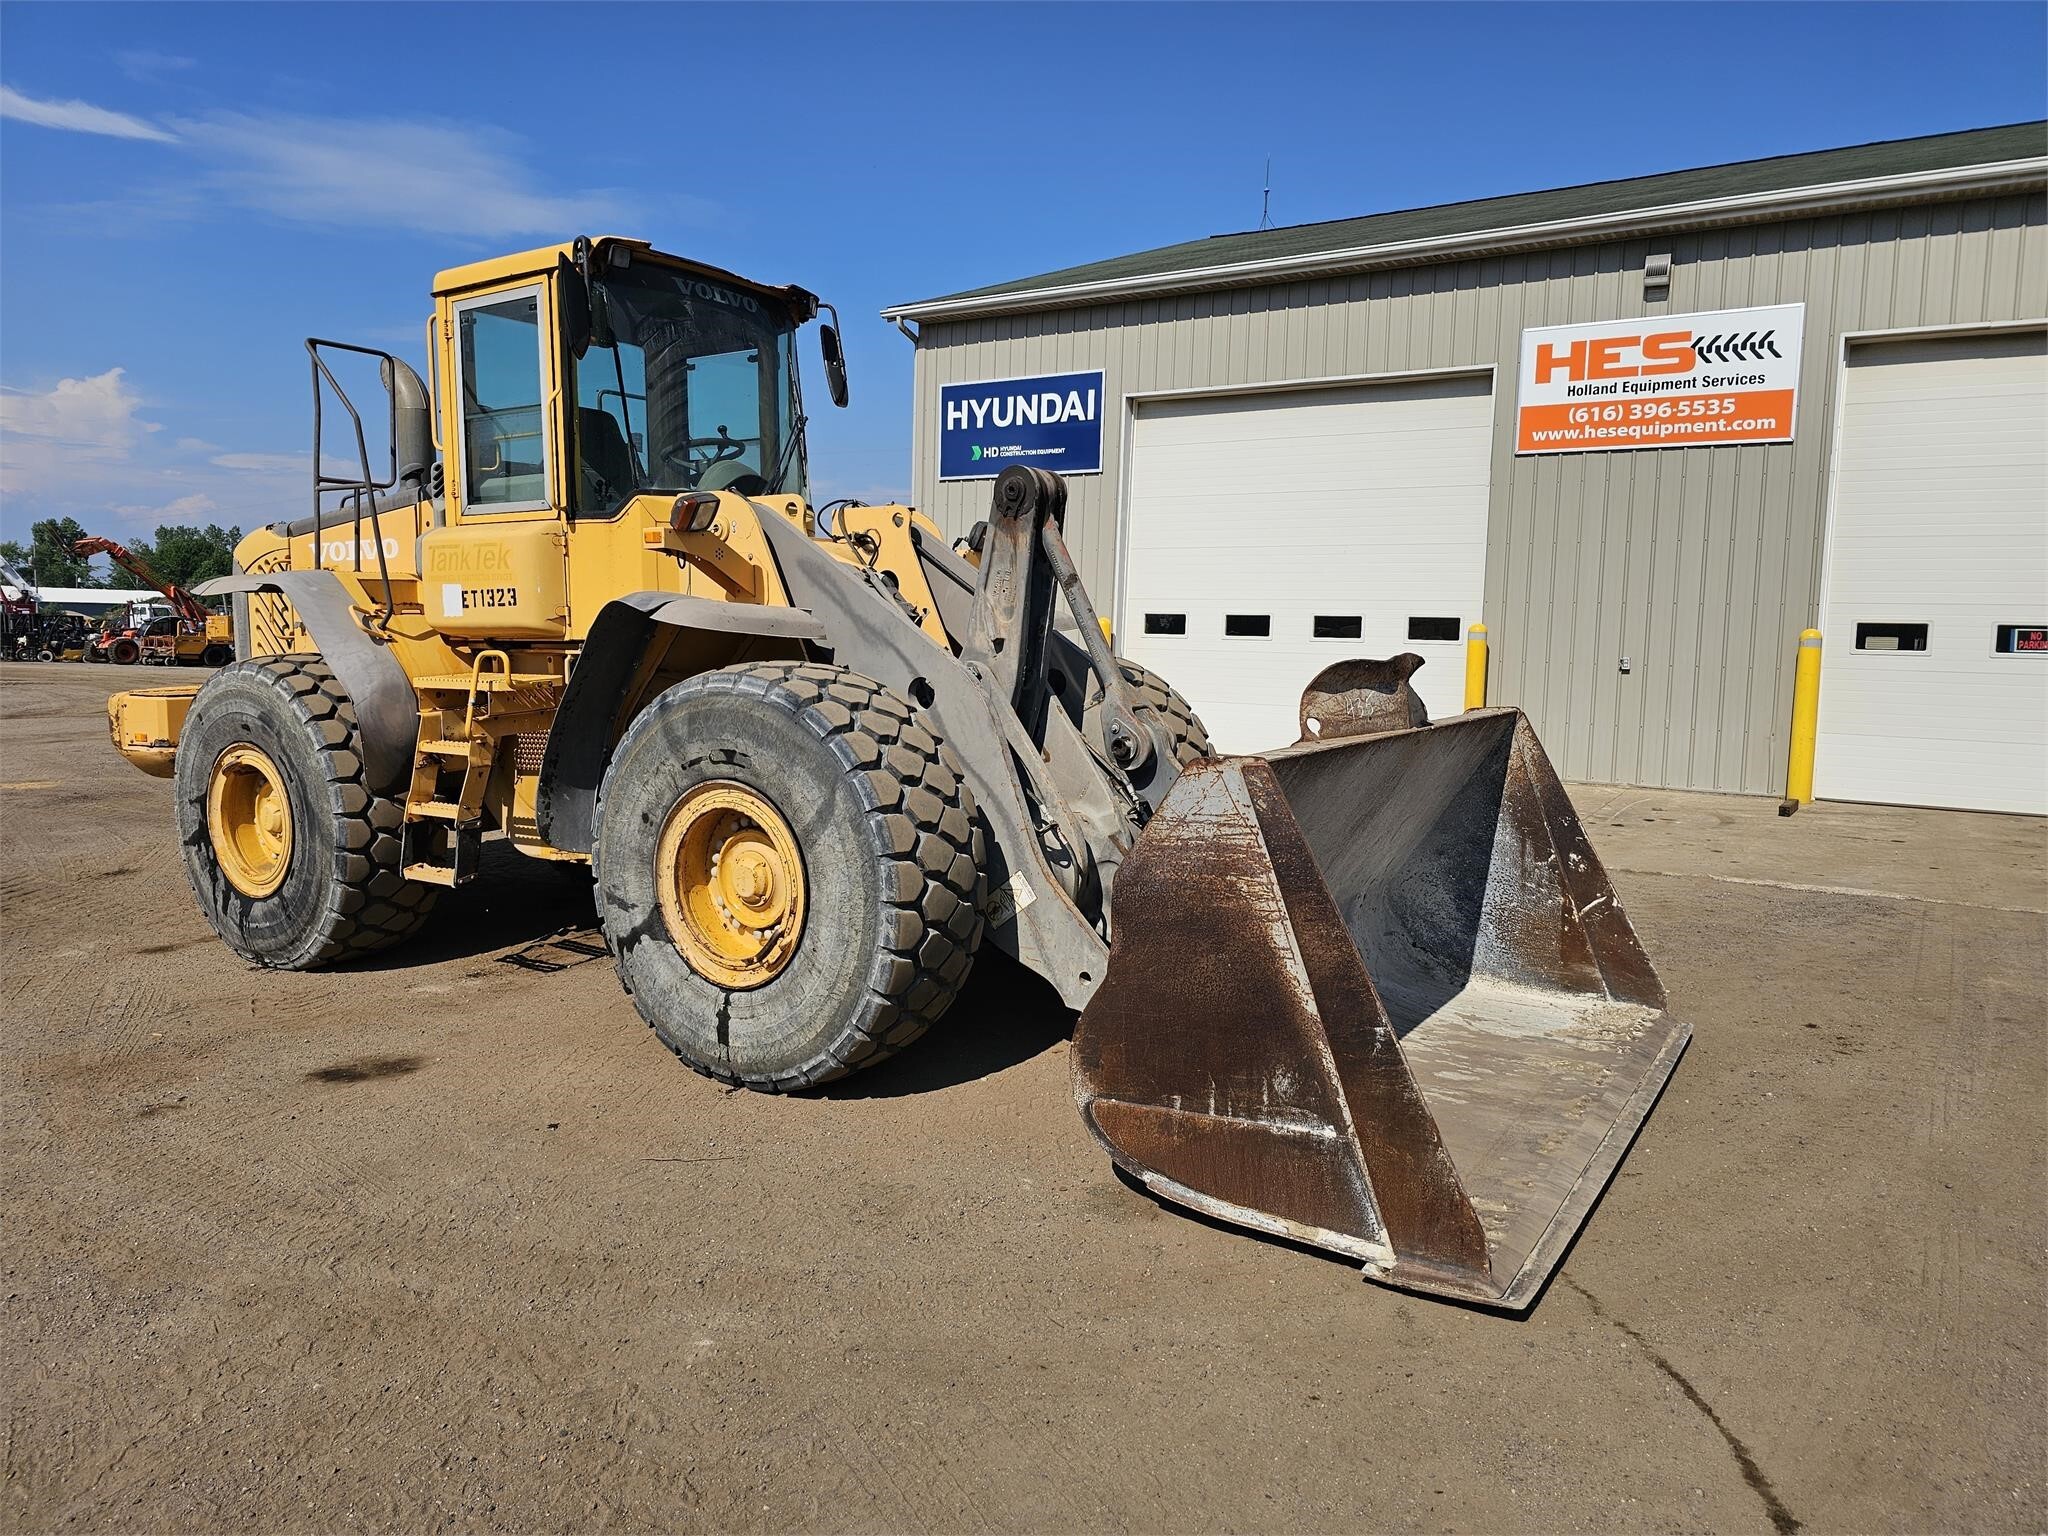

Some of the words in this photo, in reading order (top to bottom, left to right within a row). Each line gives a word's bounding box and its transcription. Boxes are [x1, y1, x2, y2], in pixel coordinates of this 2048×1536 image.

[671, 276, 759, 313] VOLVO
[1535, 331, 1696, 385] HES
[1567, 382, 1618, 397] Holland
[1622, 378, 1698, 395] Equipment
[1702, 373, 1766, 388] Services
[947, 389, 1096, 431] HYUNDAI
[1568, 403, 1624, 424] (616)
[1629, 398, 1736, 418] 396-5535
[1532, 417, 1776, 442] www.hesequipment.com
[983, 446, 999, 458] HD
[1037, 447, 1066, 455] EQUIPMENT
[308, 538, 400, 563] VOLVO
[461, 587, 518, 609] ET1323
[2030, 632, 2043, 641] NO
